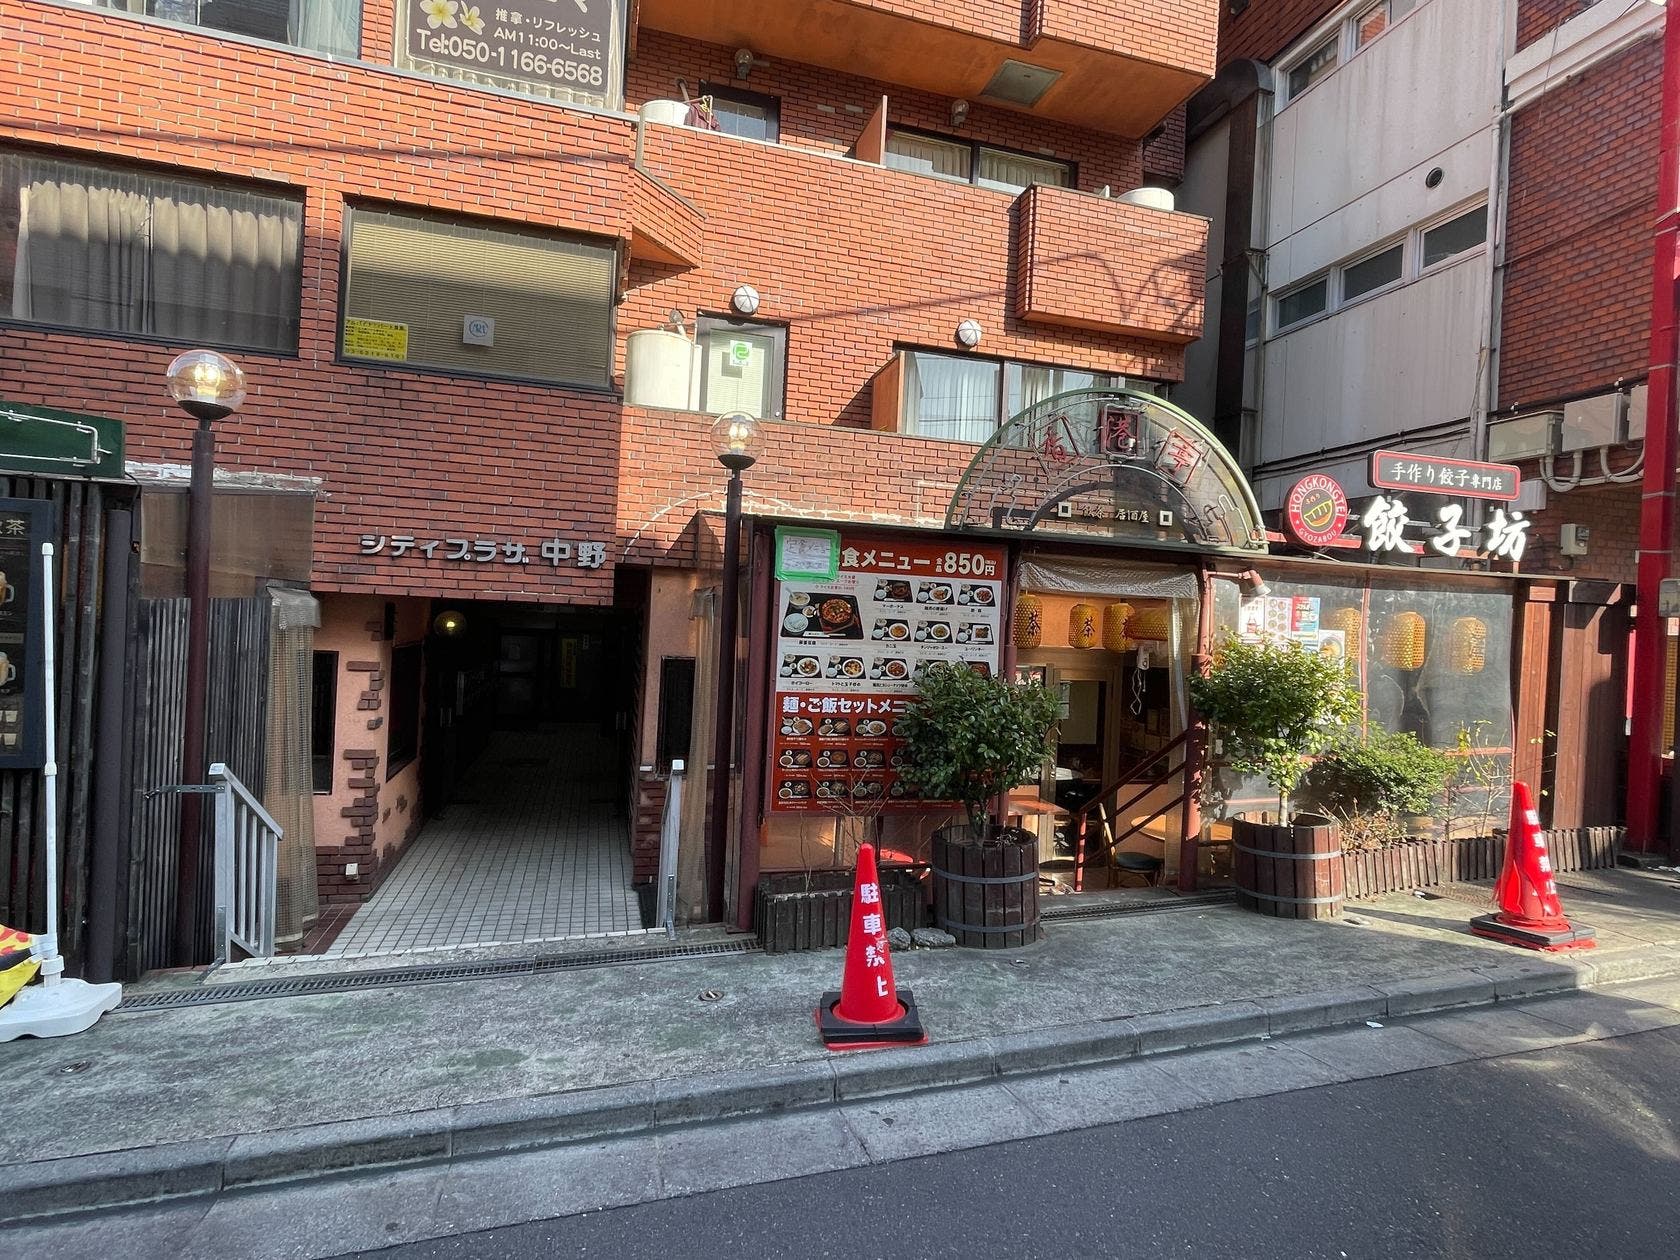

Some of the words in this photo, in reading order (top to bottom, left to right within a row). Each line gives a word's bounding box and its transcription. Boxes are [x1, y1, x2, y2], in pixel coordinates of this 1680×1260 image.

[1391, 462, 1503, 491] 手作り餃子専門店
[1364, 495, 1532, 562] 餃子坊
[837, 546, 931, 571] 食メニュー
